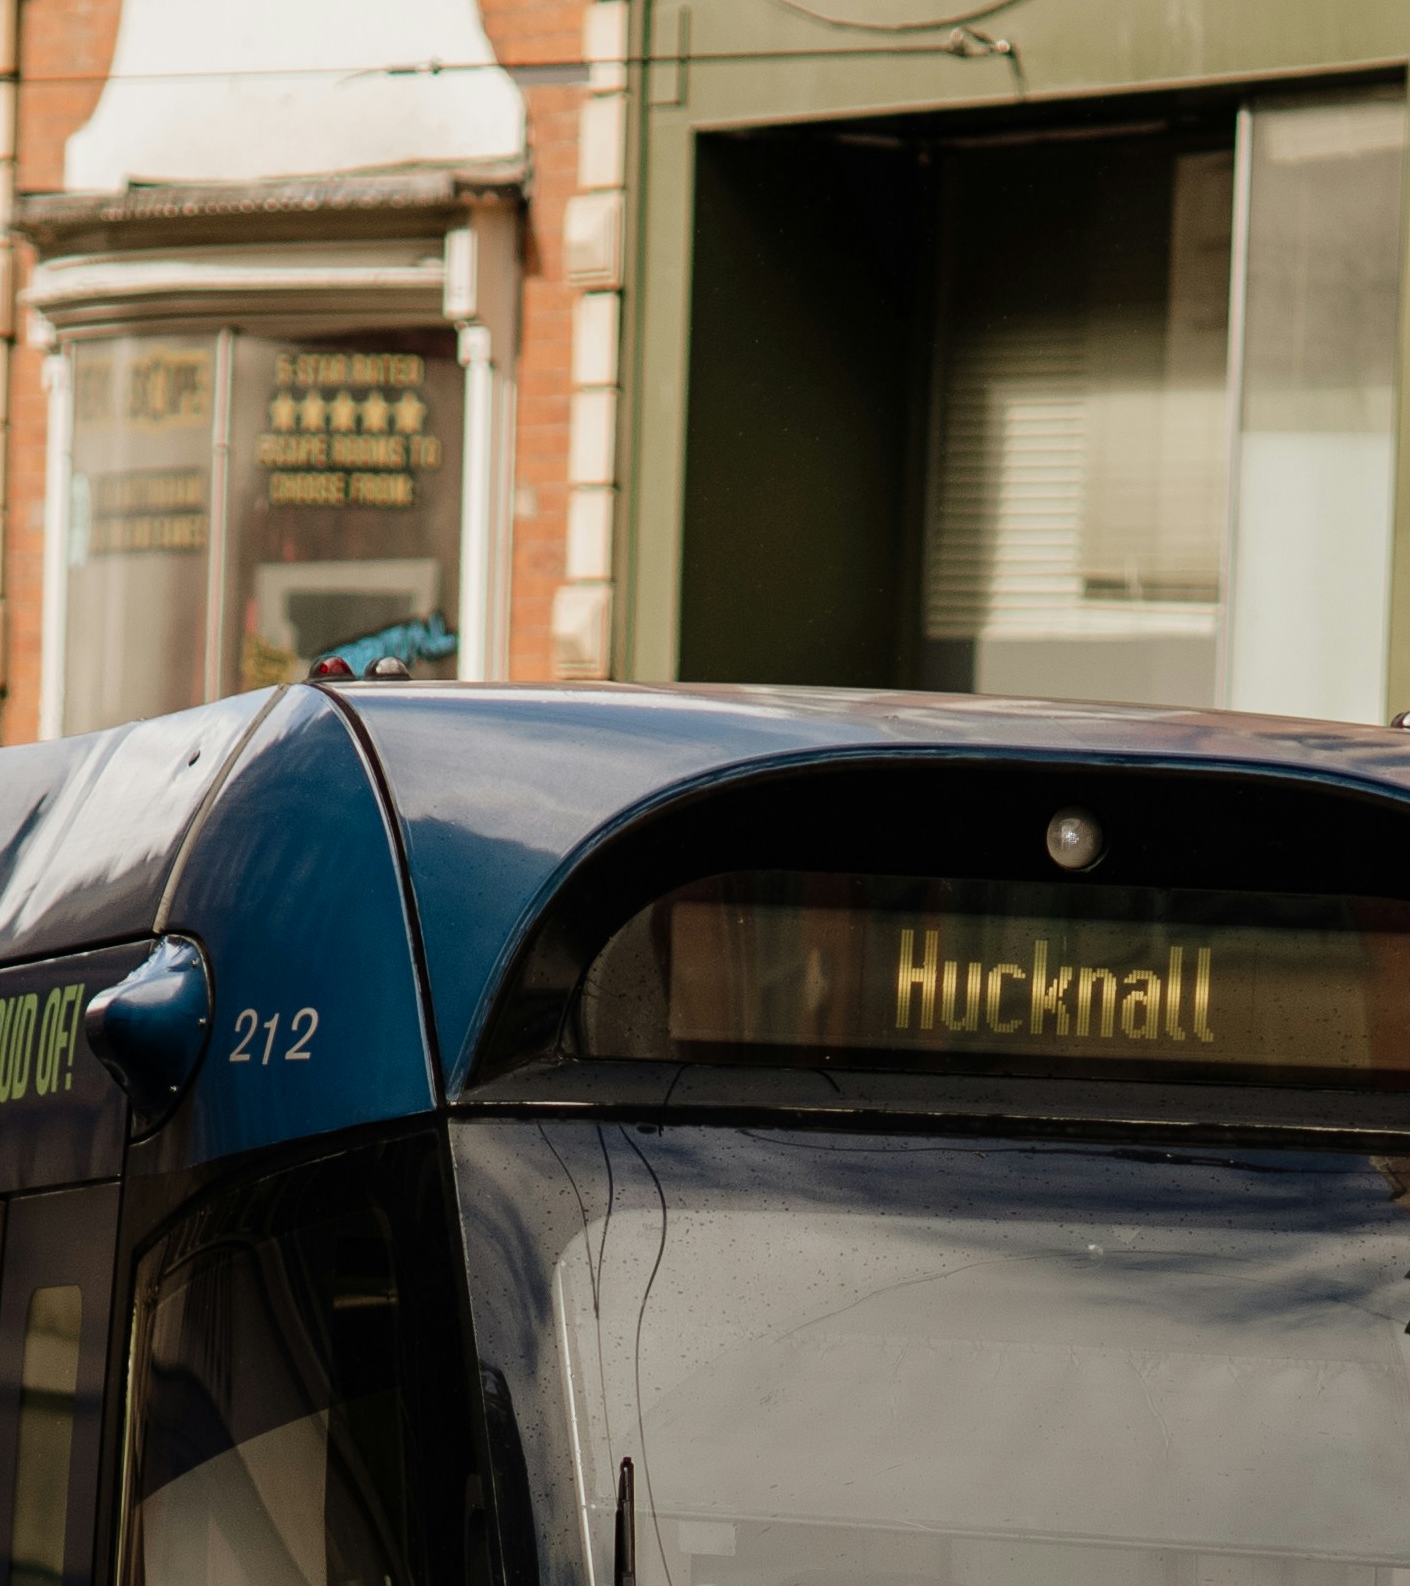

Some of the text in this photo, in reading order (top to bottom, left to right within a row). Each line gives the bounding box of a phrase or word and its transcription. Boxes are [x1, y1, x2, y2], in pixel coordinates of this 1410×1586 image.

[35, 983, 86, 1095] OF!
[229, 1007, 319, 1065] 212
[896, 929, 1215, 1043] Hucknall
